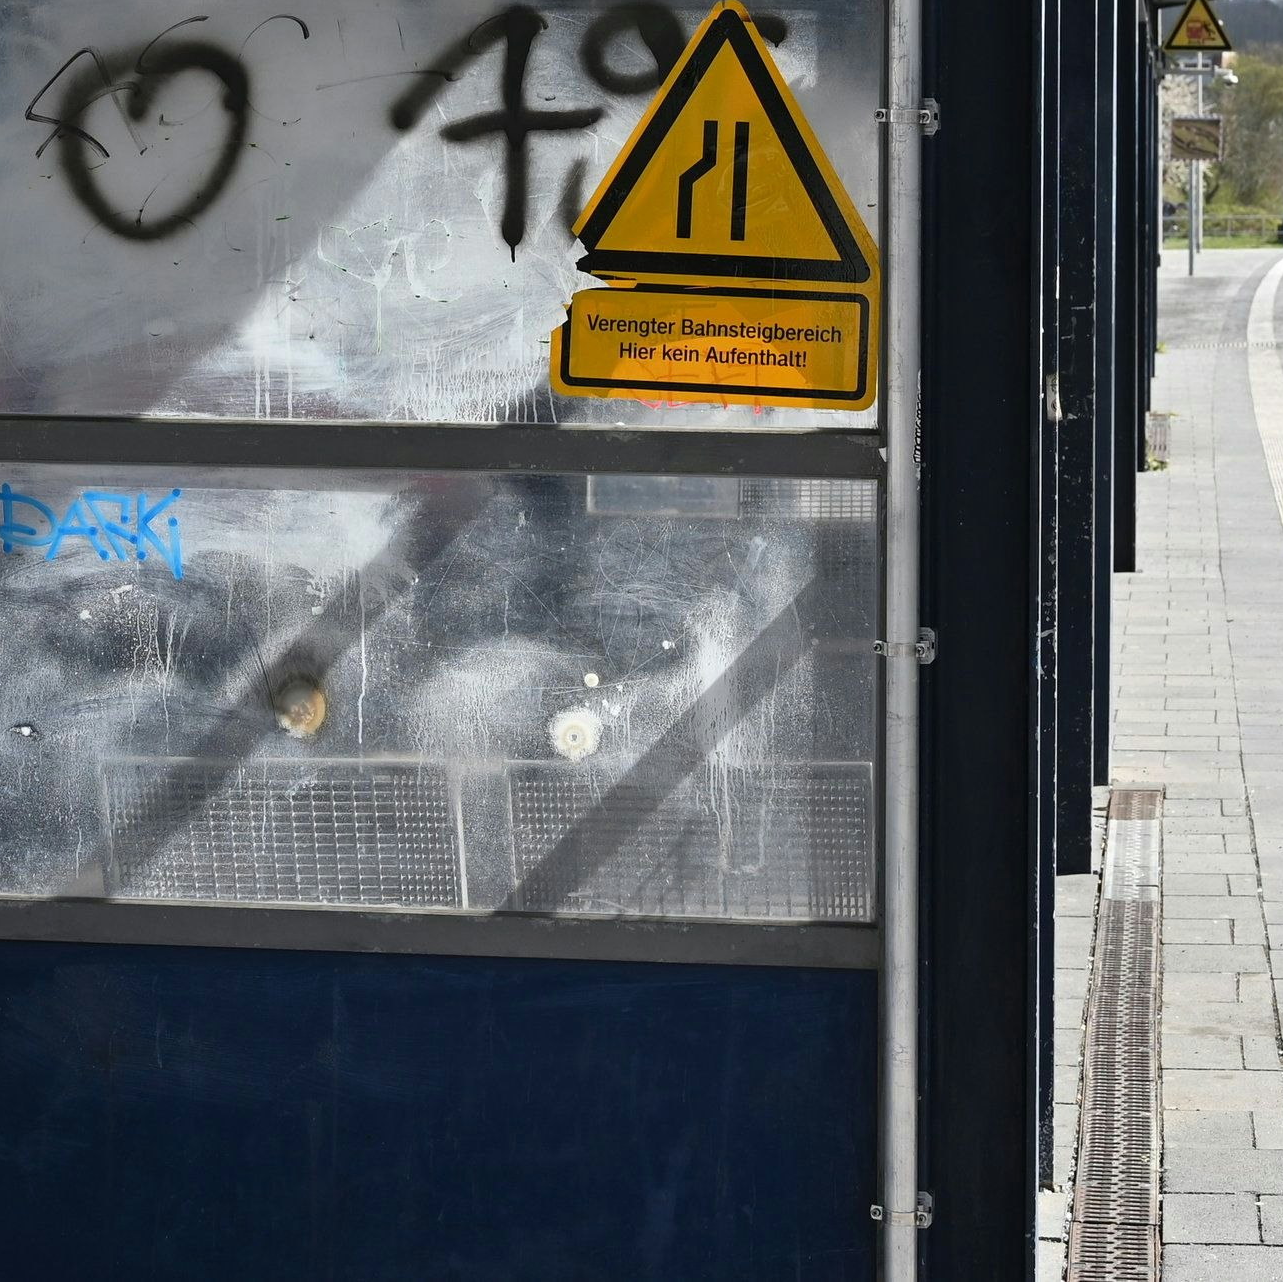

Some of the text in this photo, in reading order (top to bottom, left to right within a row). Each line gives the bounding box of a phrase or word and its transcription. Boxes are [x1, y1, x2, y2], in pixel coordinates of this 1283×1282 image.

[586, 313, 843, 345] Verengter Bahnsteigbereich
[618, 341, 808, 369] Hier kein Aufenthalt!
